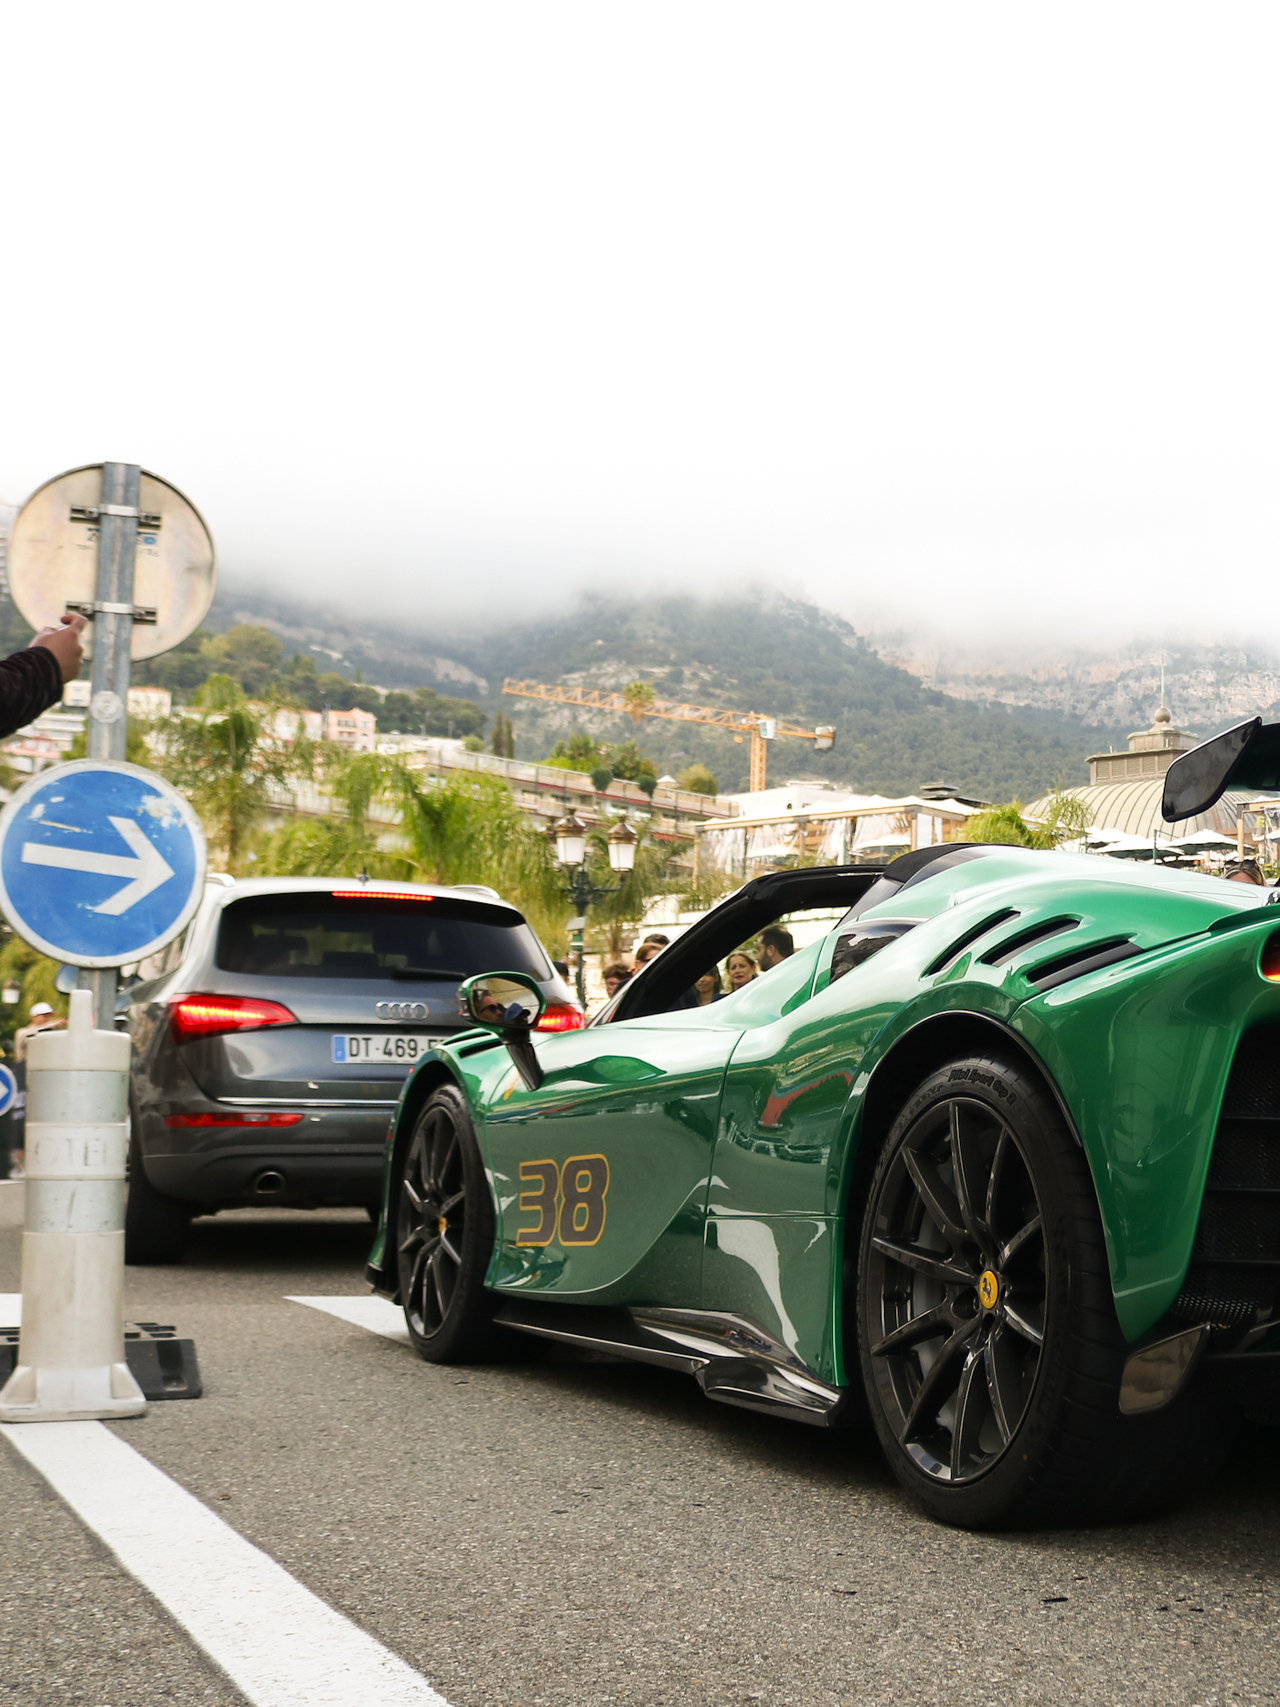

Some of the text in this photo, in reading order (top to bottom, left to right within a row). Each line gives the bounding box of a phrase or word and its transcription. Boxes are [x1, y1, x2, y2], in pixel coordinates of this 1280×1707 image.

[349, 1037, 445, 1058] DT-469-
[947, 1069, 970, 1082] Pilot
[968, 1069, 995, 1087] Sport
[992, 1080, 1009, 1098] Cup
[516, 1153, 610, 1246] 38
